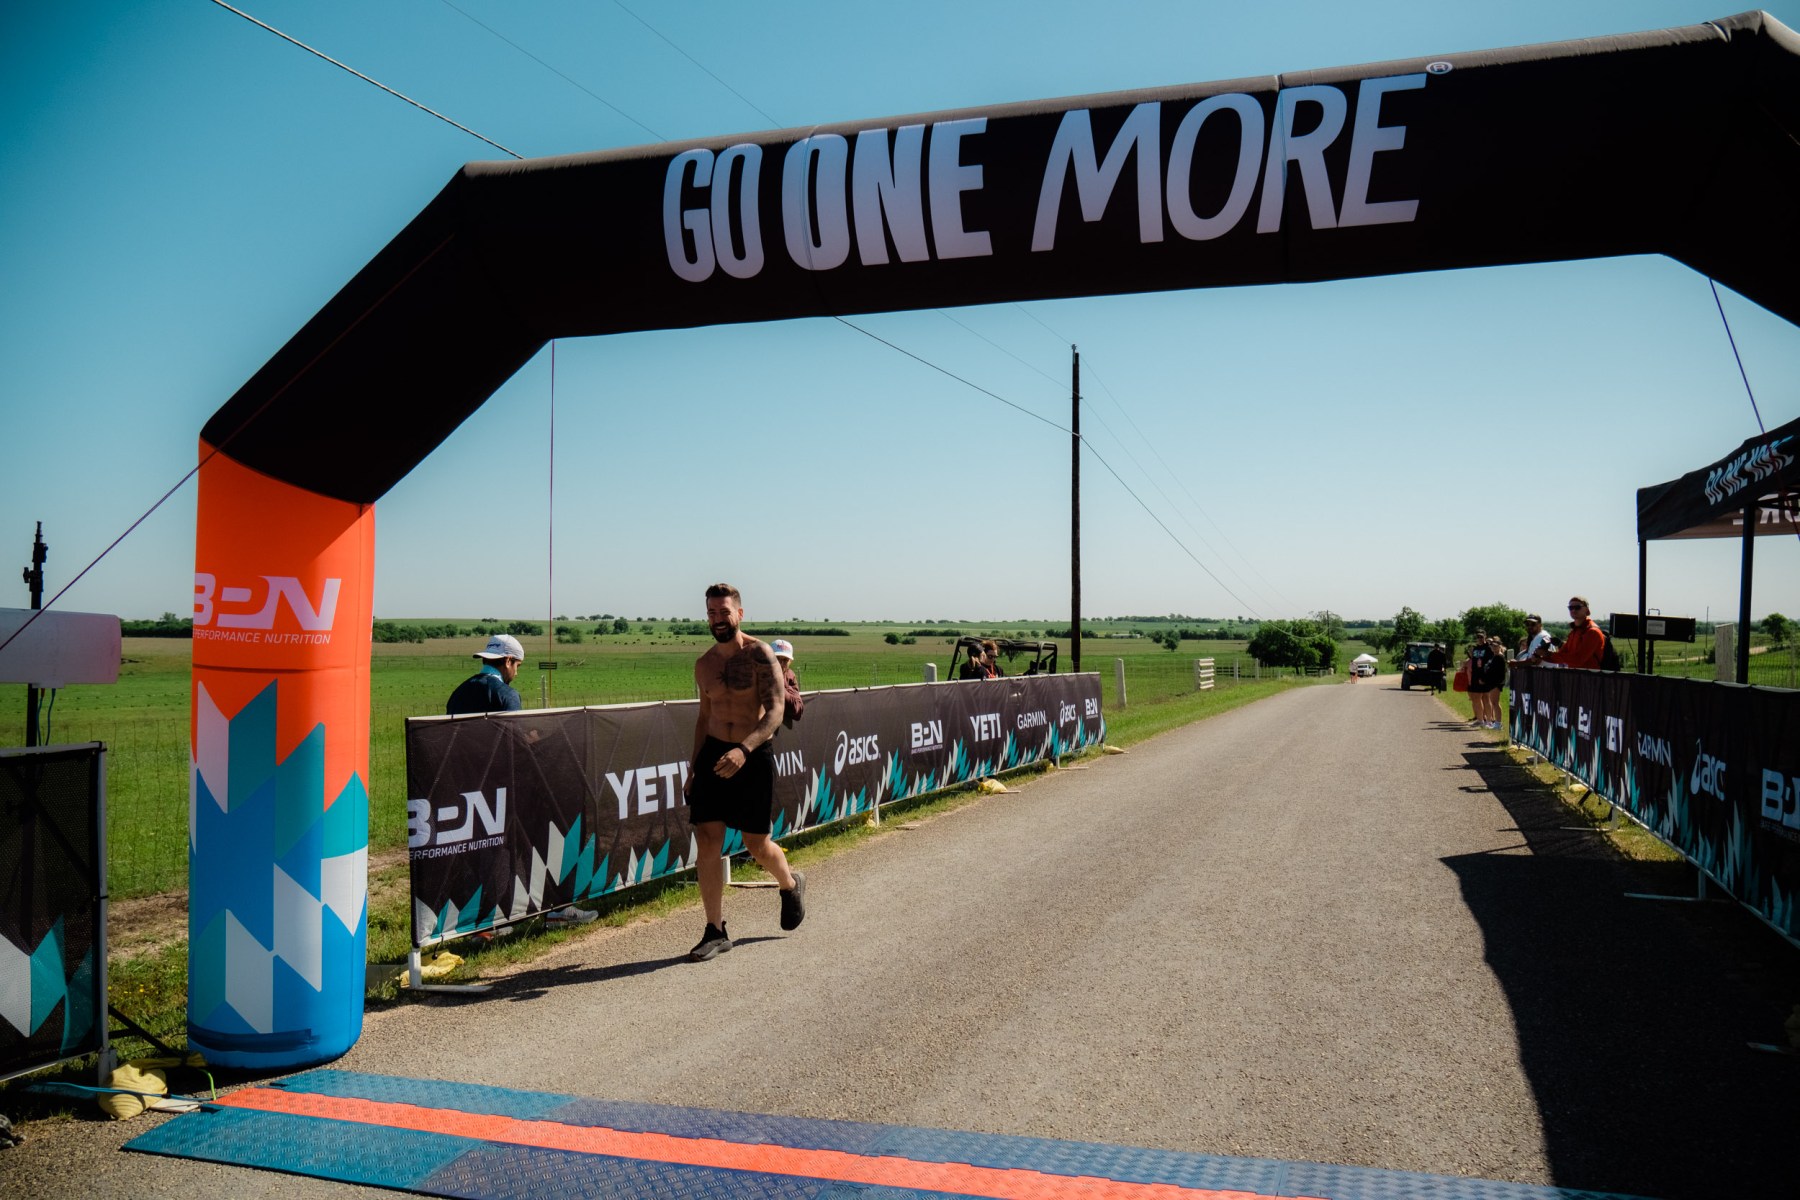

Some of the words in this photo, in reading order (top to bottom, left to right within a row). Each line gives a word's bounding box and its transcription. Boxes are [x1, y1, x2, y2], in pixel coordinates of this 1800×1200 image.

[663, 143, 764, 283] GO
[782, 117, 993, 271] ONE
[1031, 73, 1427, 252] MORE
[264, 633, 331, 645] NUTRITION
[970, 713, 1001, 742] YETI
[1017, 710, 1047, 730] GARMIN
[849, 734, 881, 765] asics
[773, 750, 806, 777] MIN
[409, 842, 467, 861] ERFORMANCE
[468, 836, 504, 851] NUTRITION
